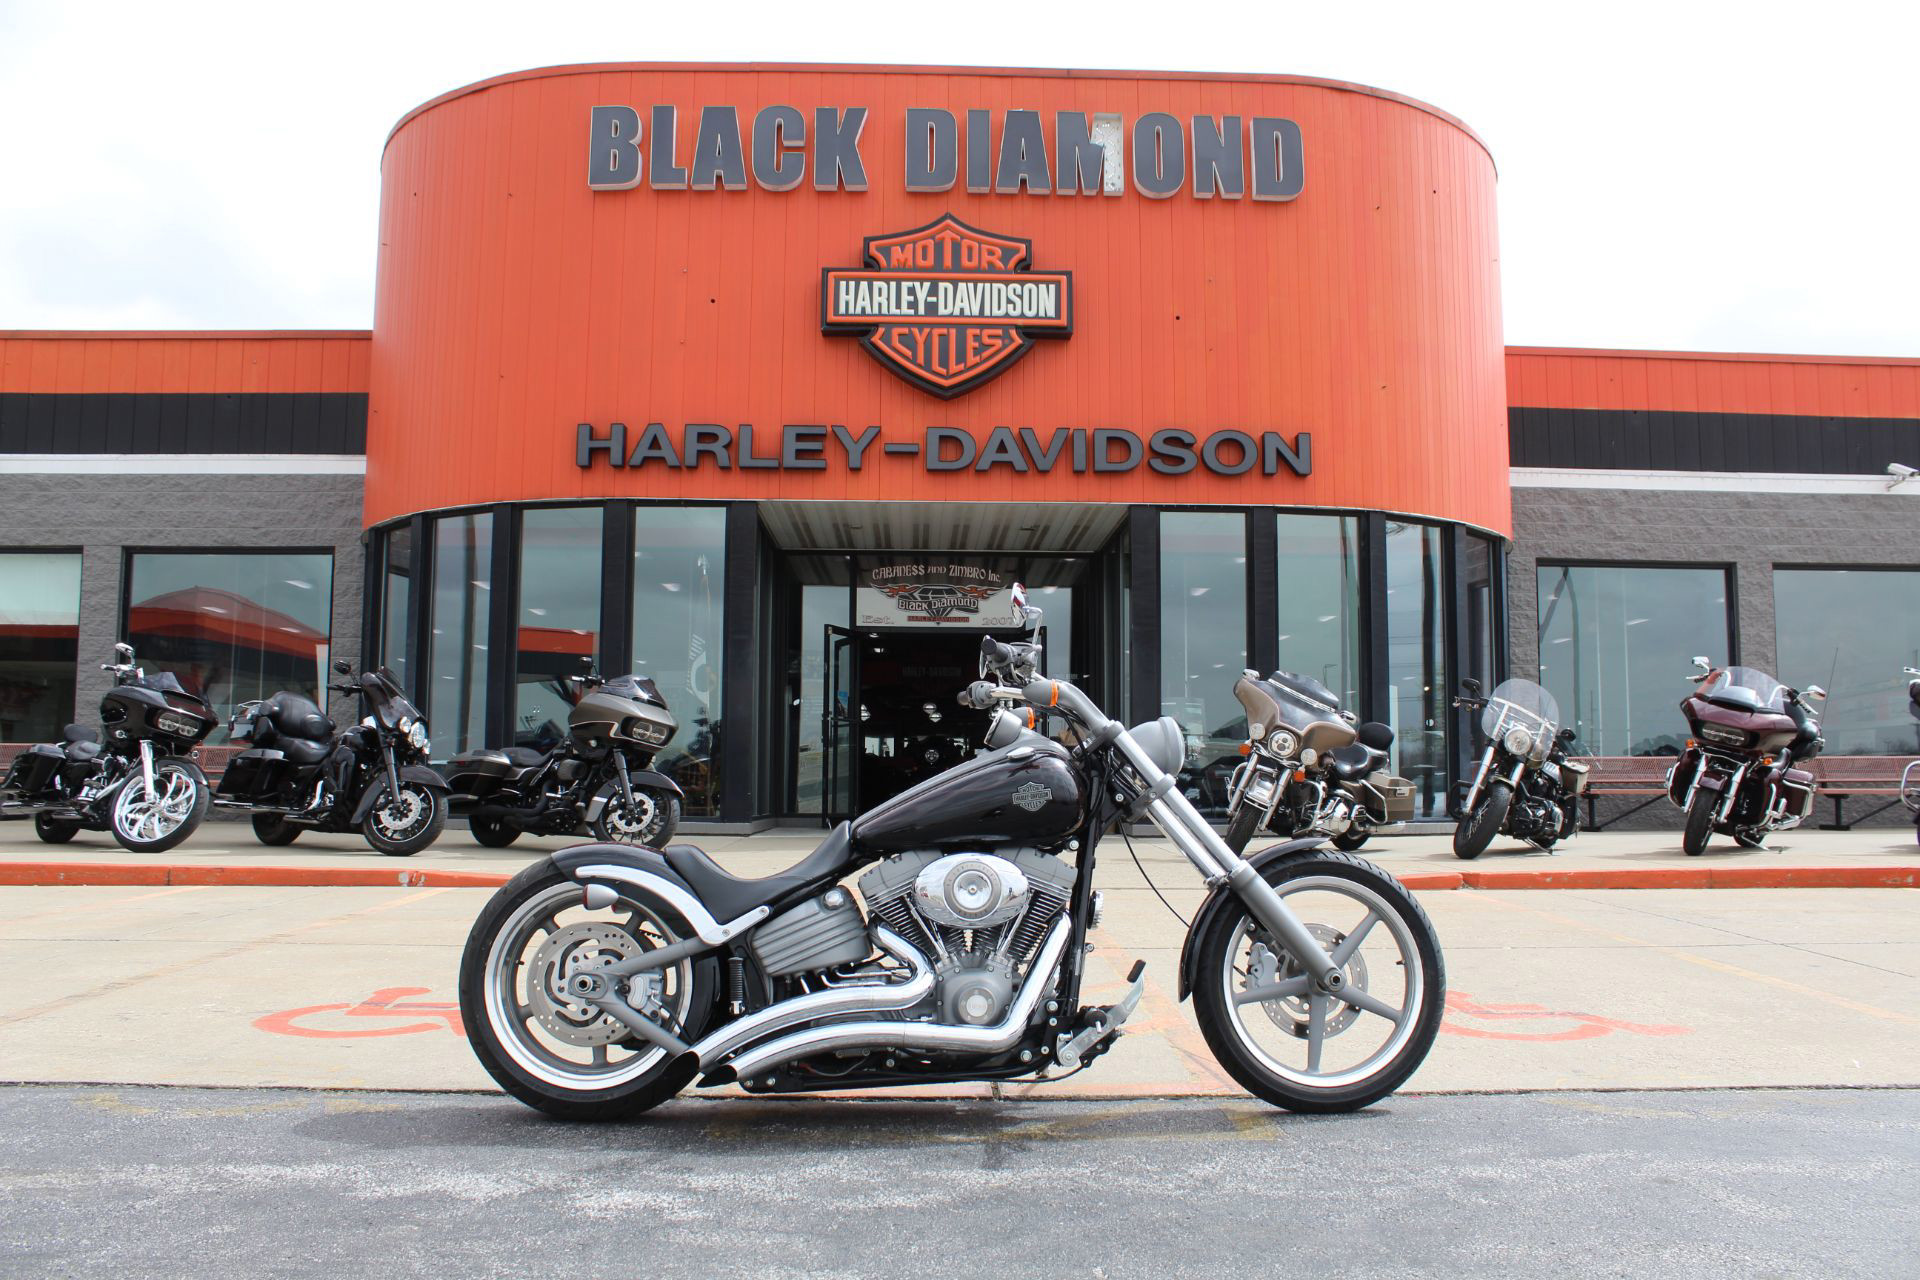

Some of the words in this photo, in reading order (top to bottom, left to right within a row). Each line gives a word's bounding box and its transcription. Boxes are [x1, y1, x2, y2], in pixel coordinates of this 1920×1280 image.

[588, 105, 868, 192] BLACK
[905, 108, 1305, 202] DIAMOND
[891, 231, 1004, 271] MOTOR
[838, 280, 1056, 319] HARLEY-DAVIDSON
[891, 327, 1003, 375] CYCLES
[576, 423, 1312, 477] HARLEY-DAVIDSON
[872, 564, 925, 580] CABANESS
[949, 564, 986, 580] ZIMBRO
